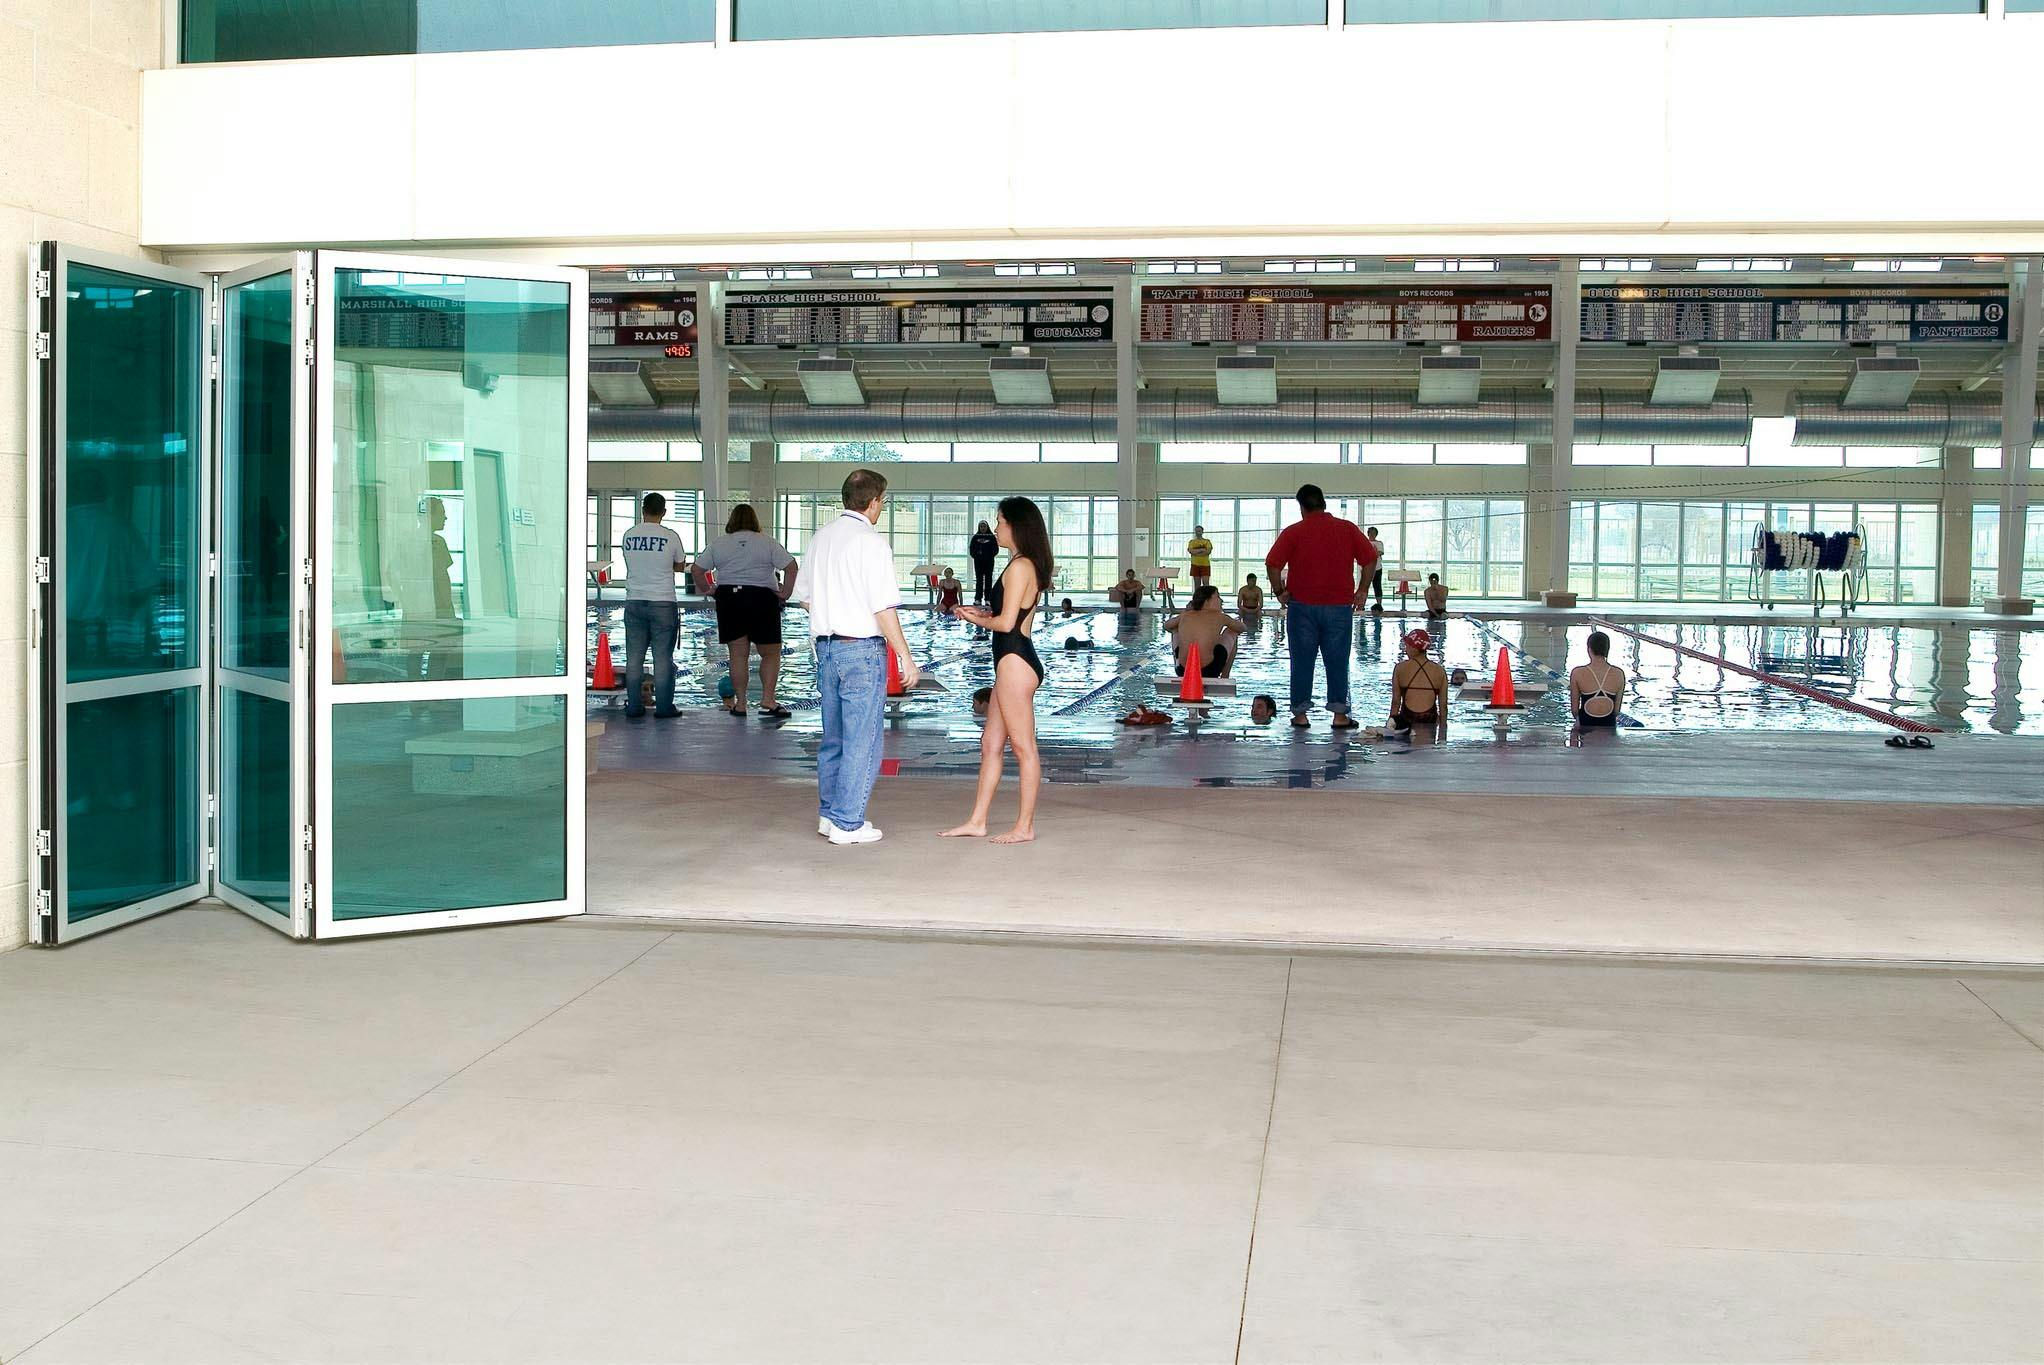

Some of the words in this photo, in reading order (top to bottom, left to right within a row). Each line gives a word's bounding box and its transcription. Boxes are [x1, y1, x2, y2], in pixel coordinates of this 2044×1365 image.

[741, 294, 788, 303] CLARK
[794, 293, 826, 302] HIGH
[830, 293, 881, 302] SCHOOL
[1152, 289, 1198, 299] TAFT
[1203, 289, 1244, 299] HIGH
[1249, 288, 1314, 299] SCHOOL
[1666, 287, 1701, 298] HIGH
[1707, 287, 1763, 298] SCHOOL
[341, 300, 412, 309] MARSHALL
[416, 299, 446, 308] HIGH
[634, 331, 679, 340] RAMS
[1034, 327, 1102, 338] COUGARS
[1473, 326, 1536, 337] RAIDERS
[1919, 326, 1999, 337] PANTHERS
[625, 536, 668, 552] STAFF
